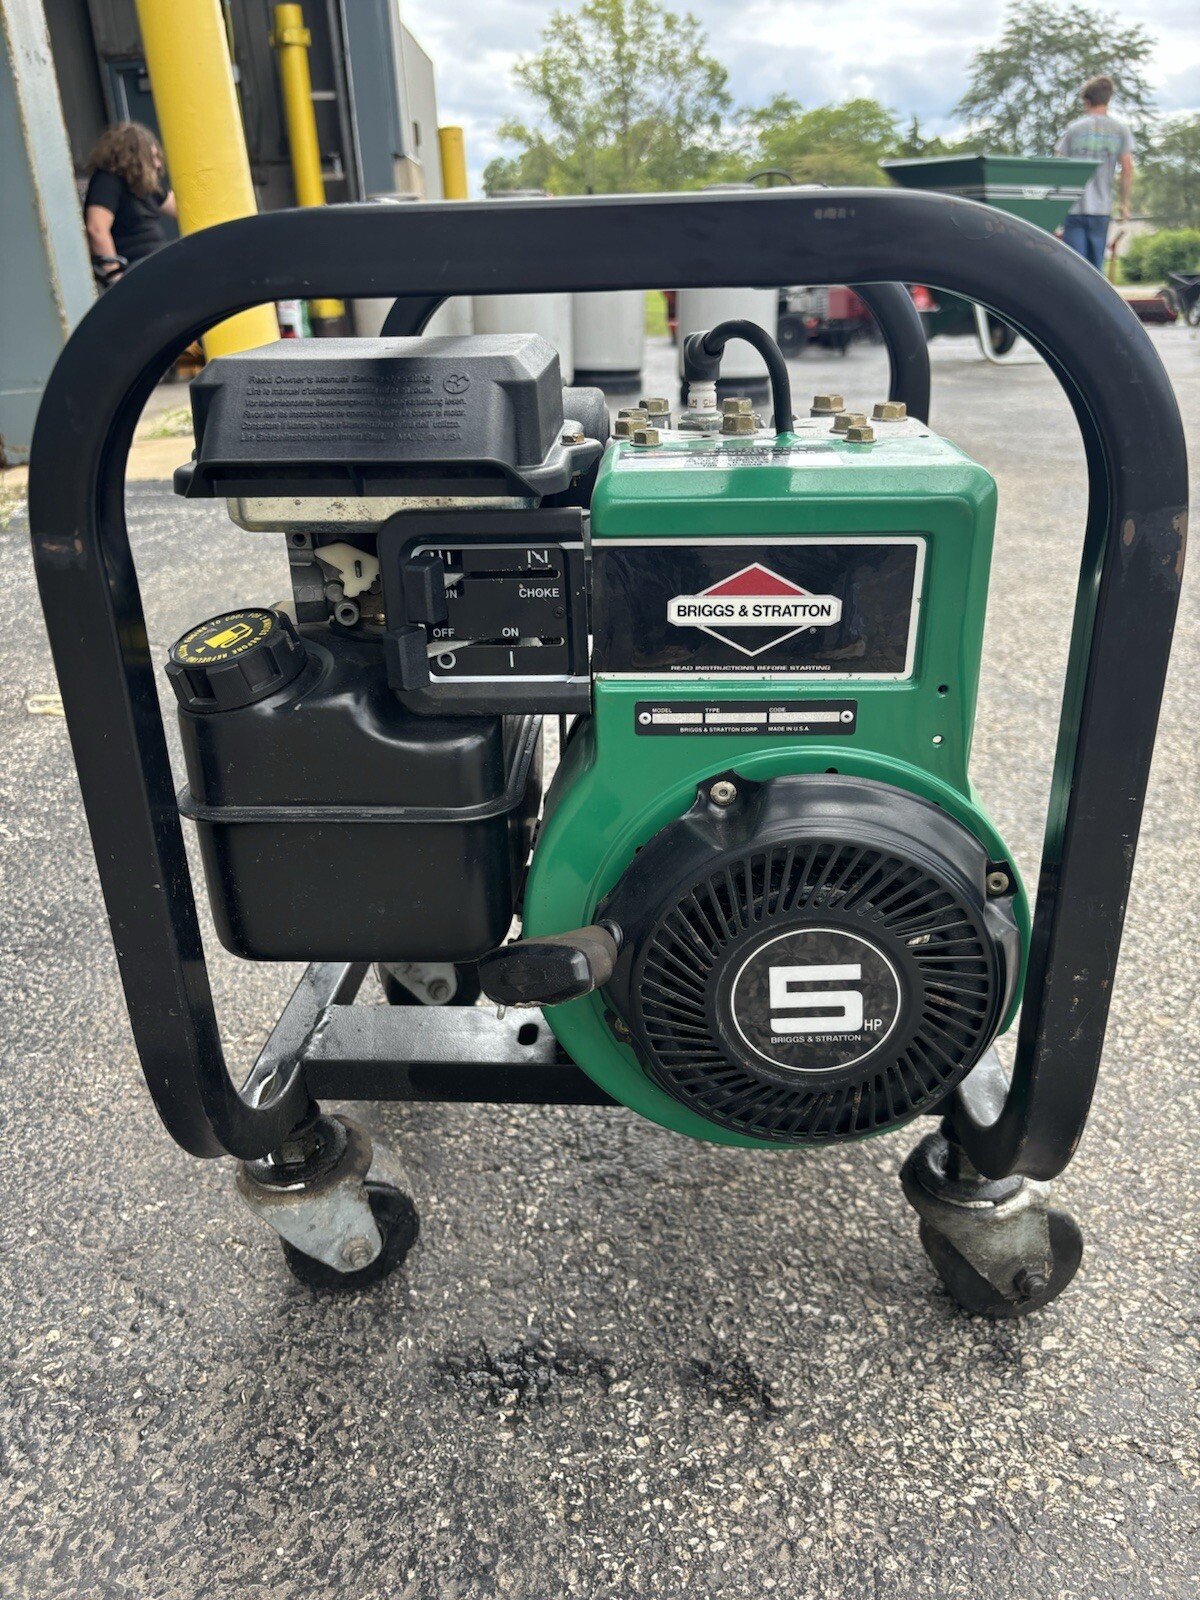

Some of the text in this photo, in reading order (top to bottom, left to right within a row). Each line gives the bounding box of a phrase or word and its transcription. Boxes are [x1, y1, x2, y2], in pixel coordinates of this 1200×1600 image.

[248, 376, 272, 384] Read
[275, 375, 313, 384] Owner's
[315, 375, 349, 383] Manual
[519, 588, 560, 598] CHOKE
[677, 604, 832, 617] BRIGGS & STRATTON
[225, 613, 245, 622] COOL
[432, 627, 520, 638] OFF ON
[768, 963, 883, 1034] 5 HP
[770, 1036, 805, 1044] BRIGGS
[815, 1034, 862, 1043] STRATTON
